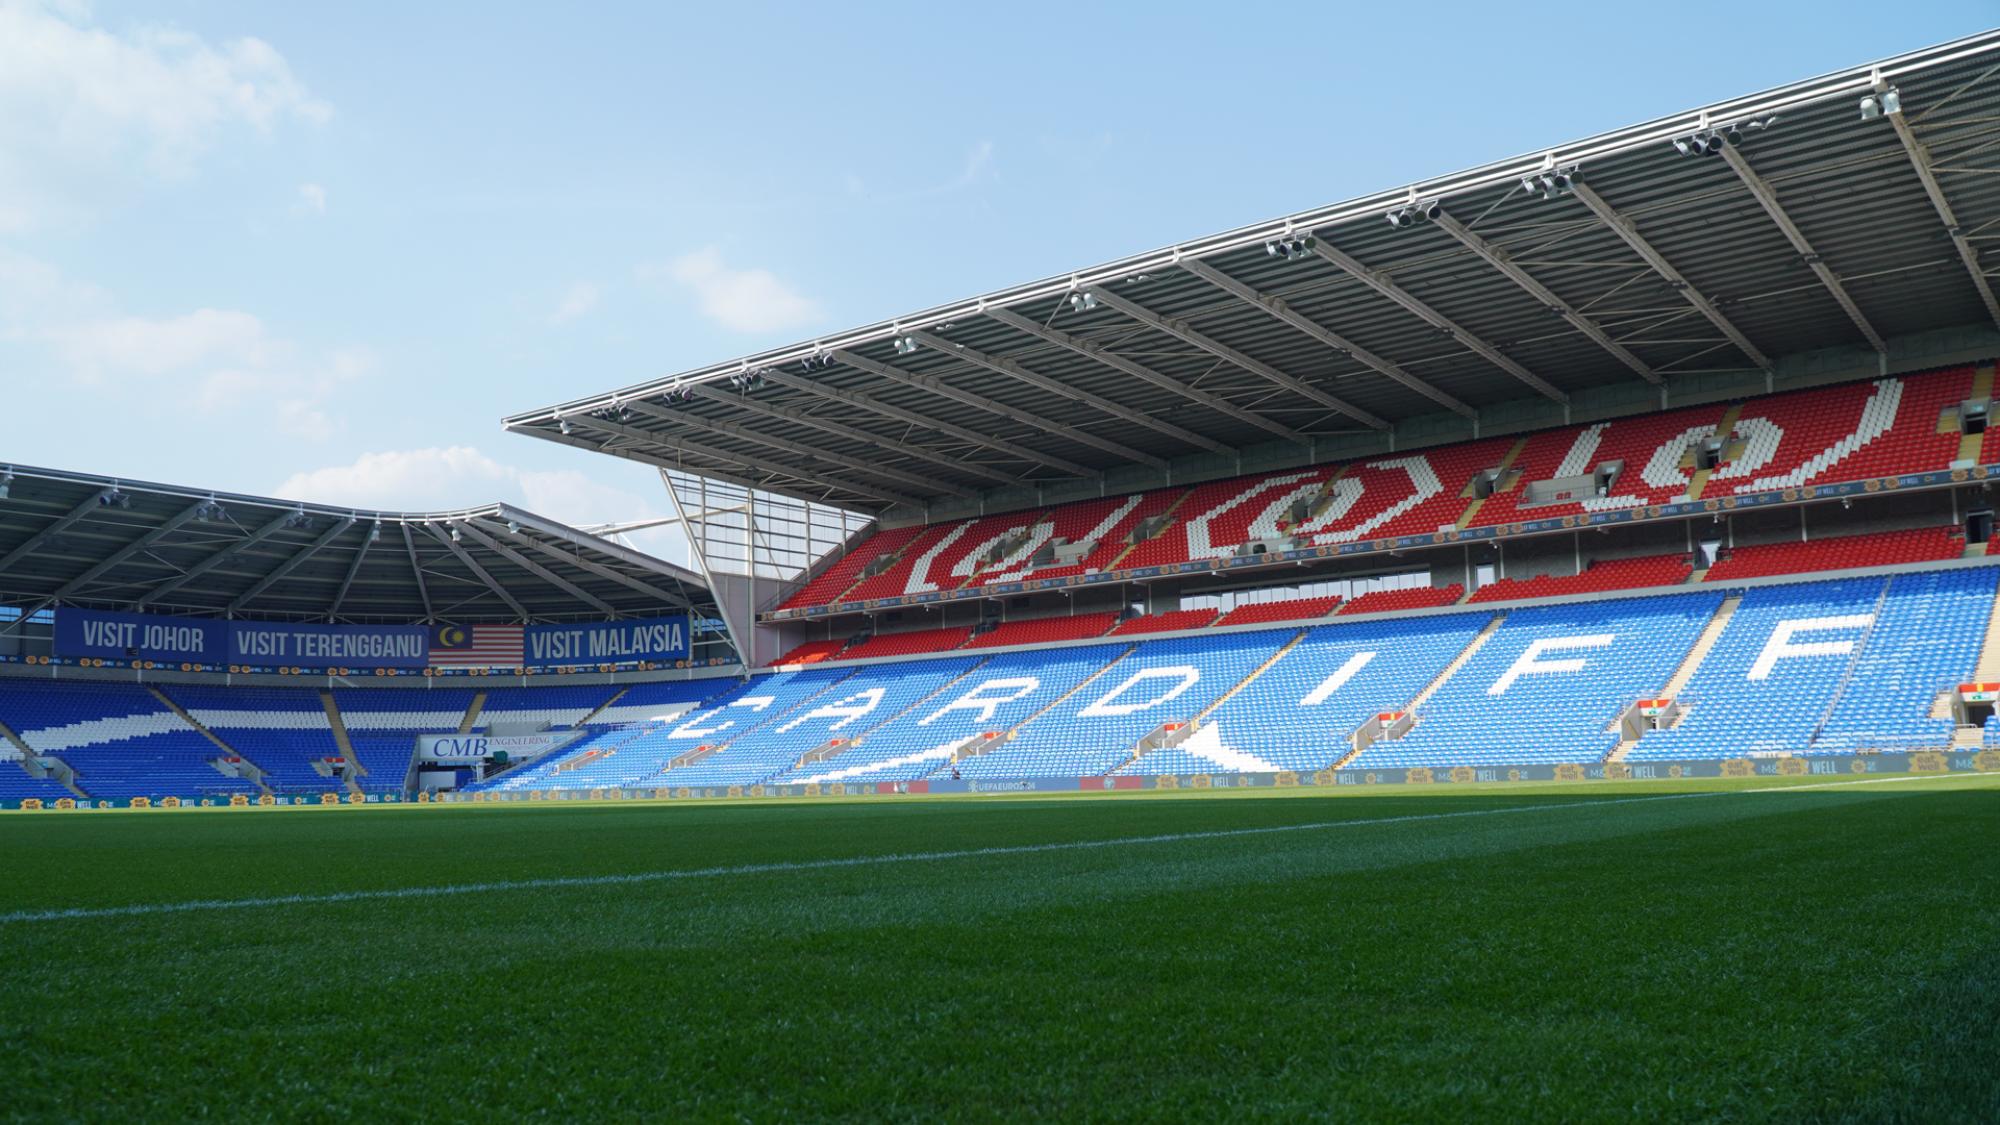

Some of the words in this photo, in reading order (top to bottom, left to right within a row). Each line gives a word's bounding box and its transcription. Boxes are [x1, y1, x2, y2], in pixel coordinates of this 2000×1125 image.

[83, 620, 137, 648] VISIT
[141, 624, 204, 652] JOHOR
[237, 631, 288, 656] VISIT
[293, 633, 422, 658] TERENGGANU
[531, 630, 583, 659] VISIT
[589, 623, 684, 657] MALAYSIA
[668, 614, 1874, 739] CARDIFF
[433, 738, 489, 757] CMB
[489, 736, 550, 746] ENGINEERING
[1478, 769, 1498, 782] WELL
[1634, 766, 1657, 778] WELL
[1812, 761, 1838, 774] WELL
[1339, 773, 1356, 785] WELL
